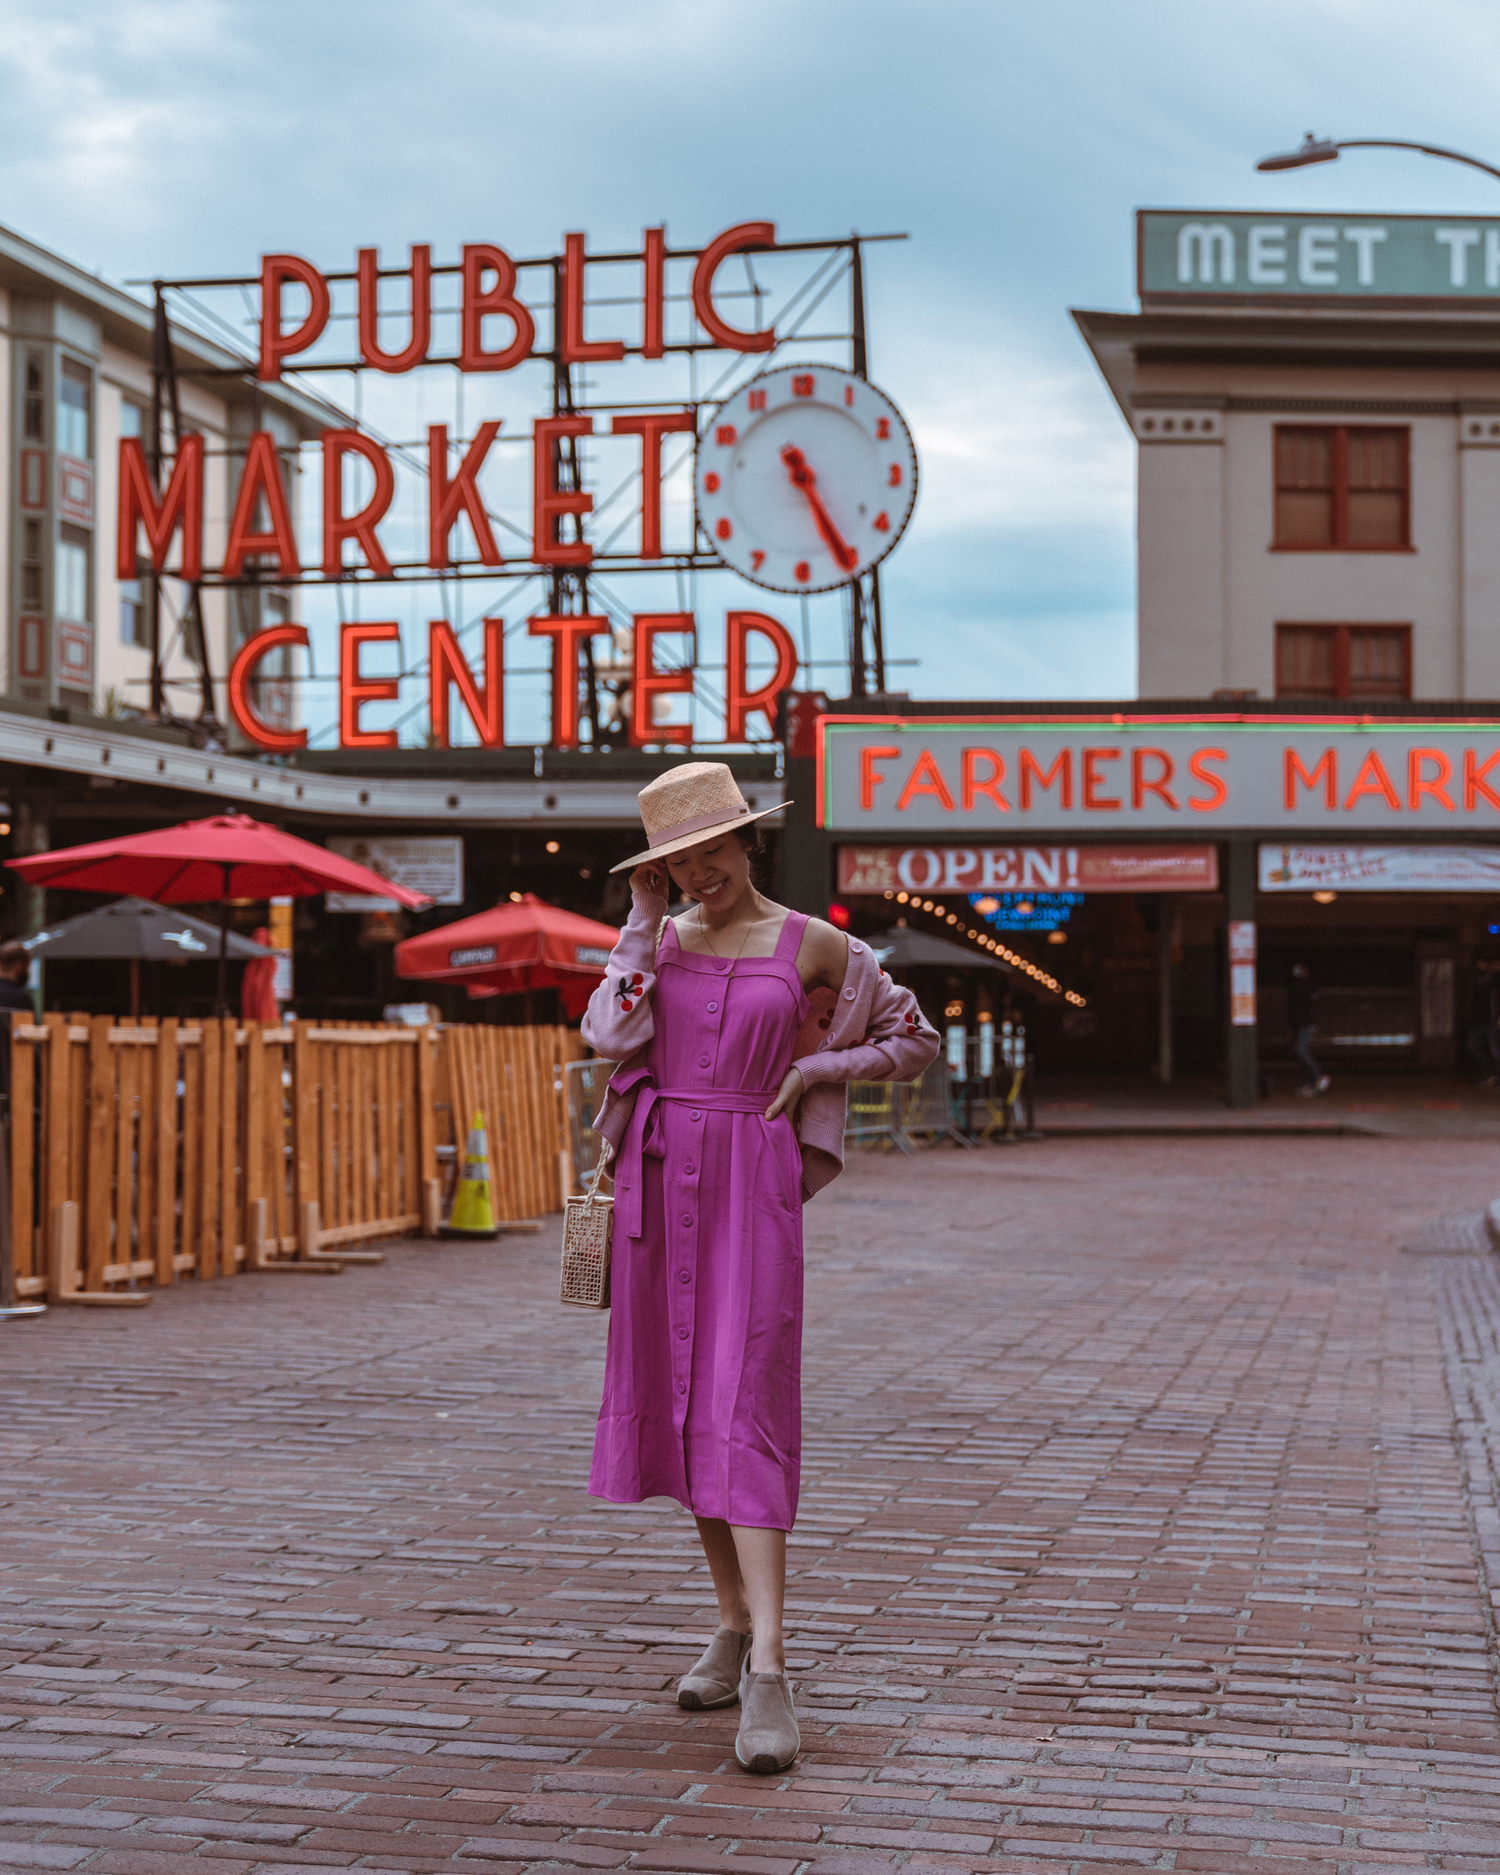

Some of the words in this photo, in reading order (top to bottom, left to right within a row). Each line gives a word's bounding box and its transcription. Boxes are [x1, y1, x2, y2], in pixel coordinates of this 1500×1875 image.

[1176, 221, 1388, 287] MEET
[258, 221, 776, 381] PUBLIC
[792, 374, 815, 397] 12
[715, 423, 737, 446] 10
[875, 416, 891, 440] 2
[703, 471, 721, 494] 9
[887, 463, 903, 487] 3
[117, 412, 697, 581] MARKET
[715, 516, 732, 540] 8
[873, 511, 890, 533] 4
[751, 550, 765, 572] 7
[794, 560, 812, 584] 6
[229, 611, 799, 751] CENTER
[858, 746, 1229, 812] FARMERS
[1282, 746, 1500, 813] MARK
[898, 848, 1079, 889] OPEN!
